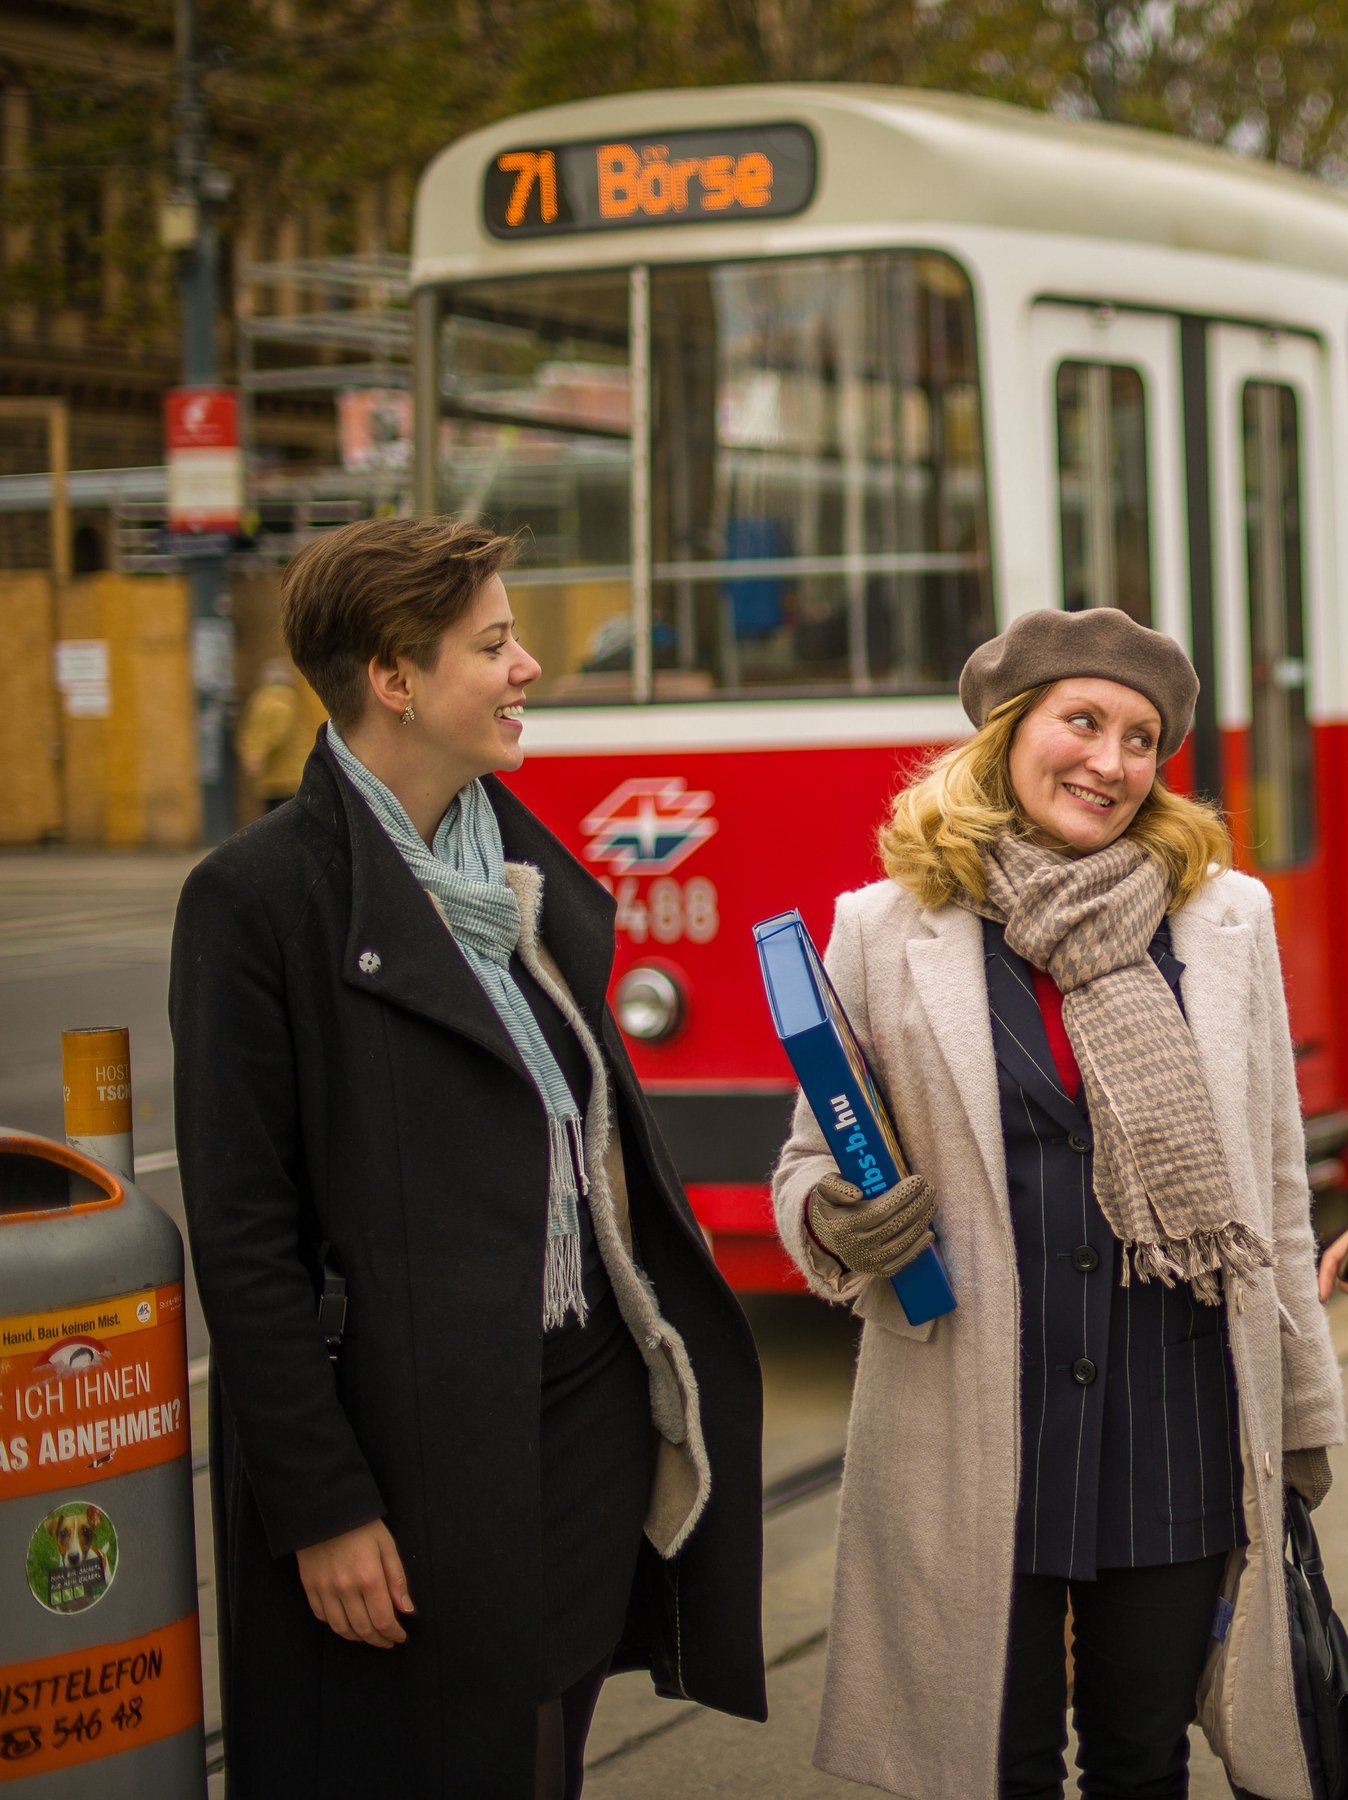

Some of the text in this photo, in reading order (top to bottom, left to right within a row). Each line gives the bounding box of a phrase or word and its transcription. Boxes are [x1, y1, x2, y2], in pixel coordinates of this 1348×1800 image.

[497, 143, 774, 227] 71 Börse
[598, 875, 720, 944] 488
[2, 1313, 121, 1345] Hand. Bau keinen Mist.
[15, 1381, 65, 1421] ICH
[75, 1361, 151, 1410] IHNEN
[38, 1398, 181, 1466] ABNEHMEN?
[0, 1648, 163, 1718] ISTTELEFON
[52, 1695, 144, 1749] 546 48
